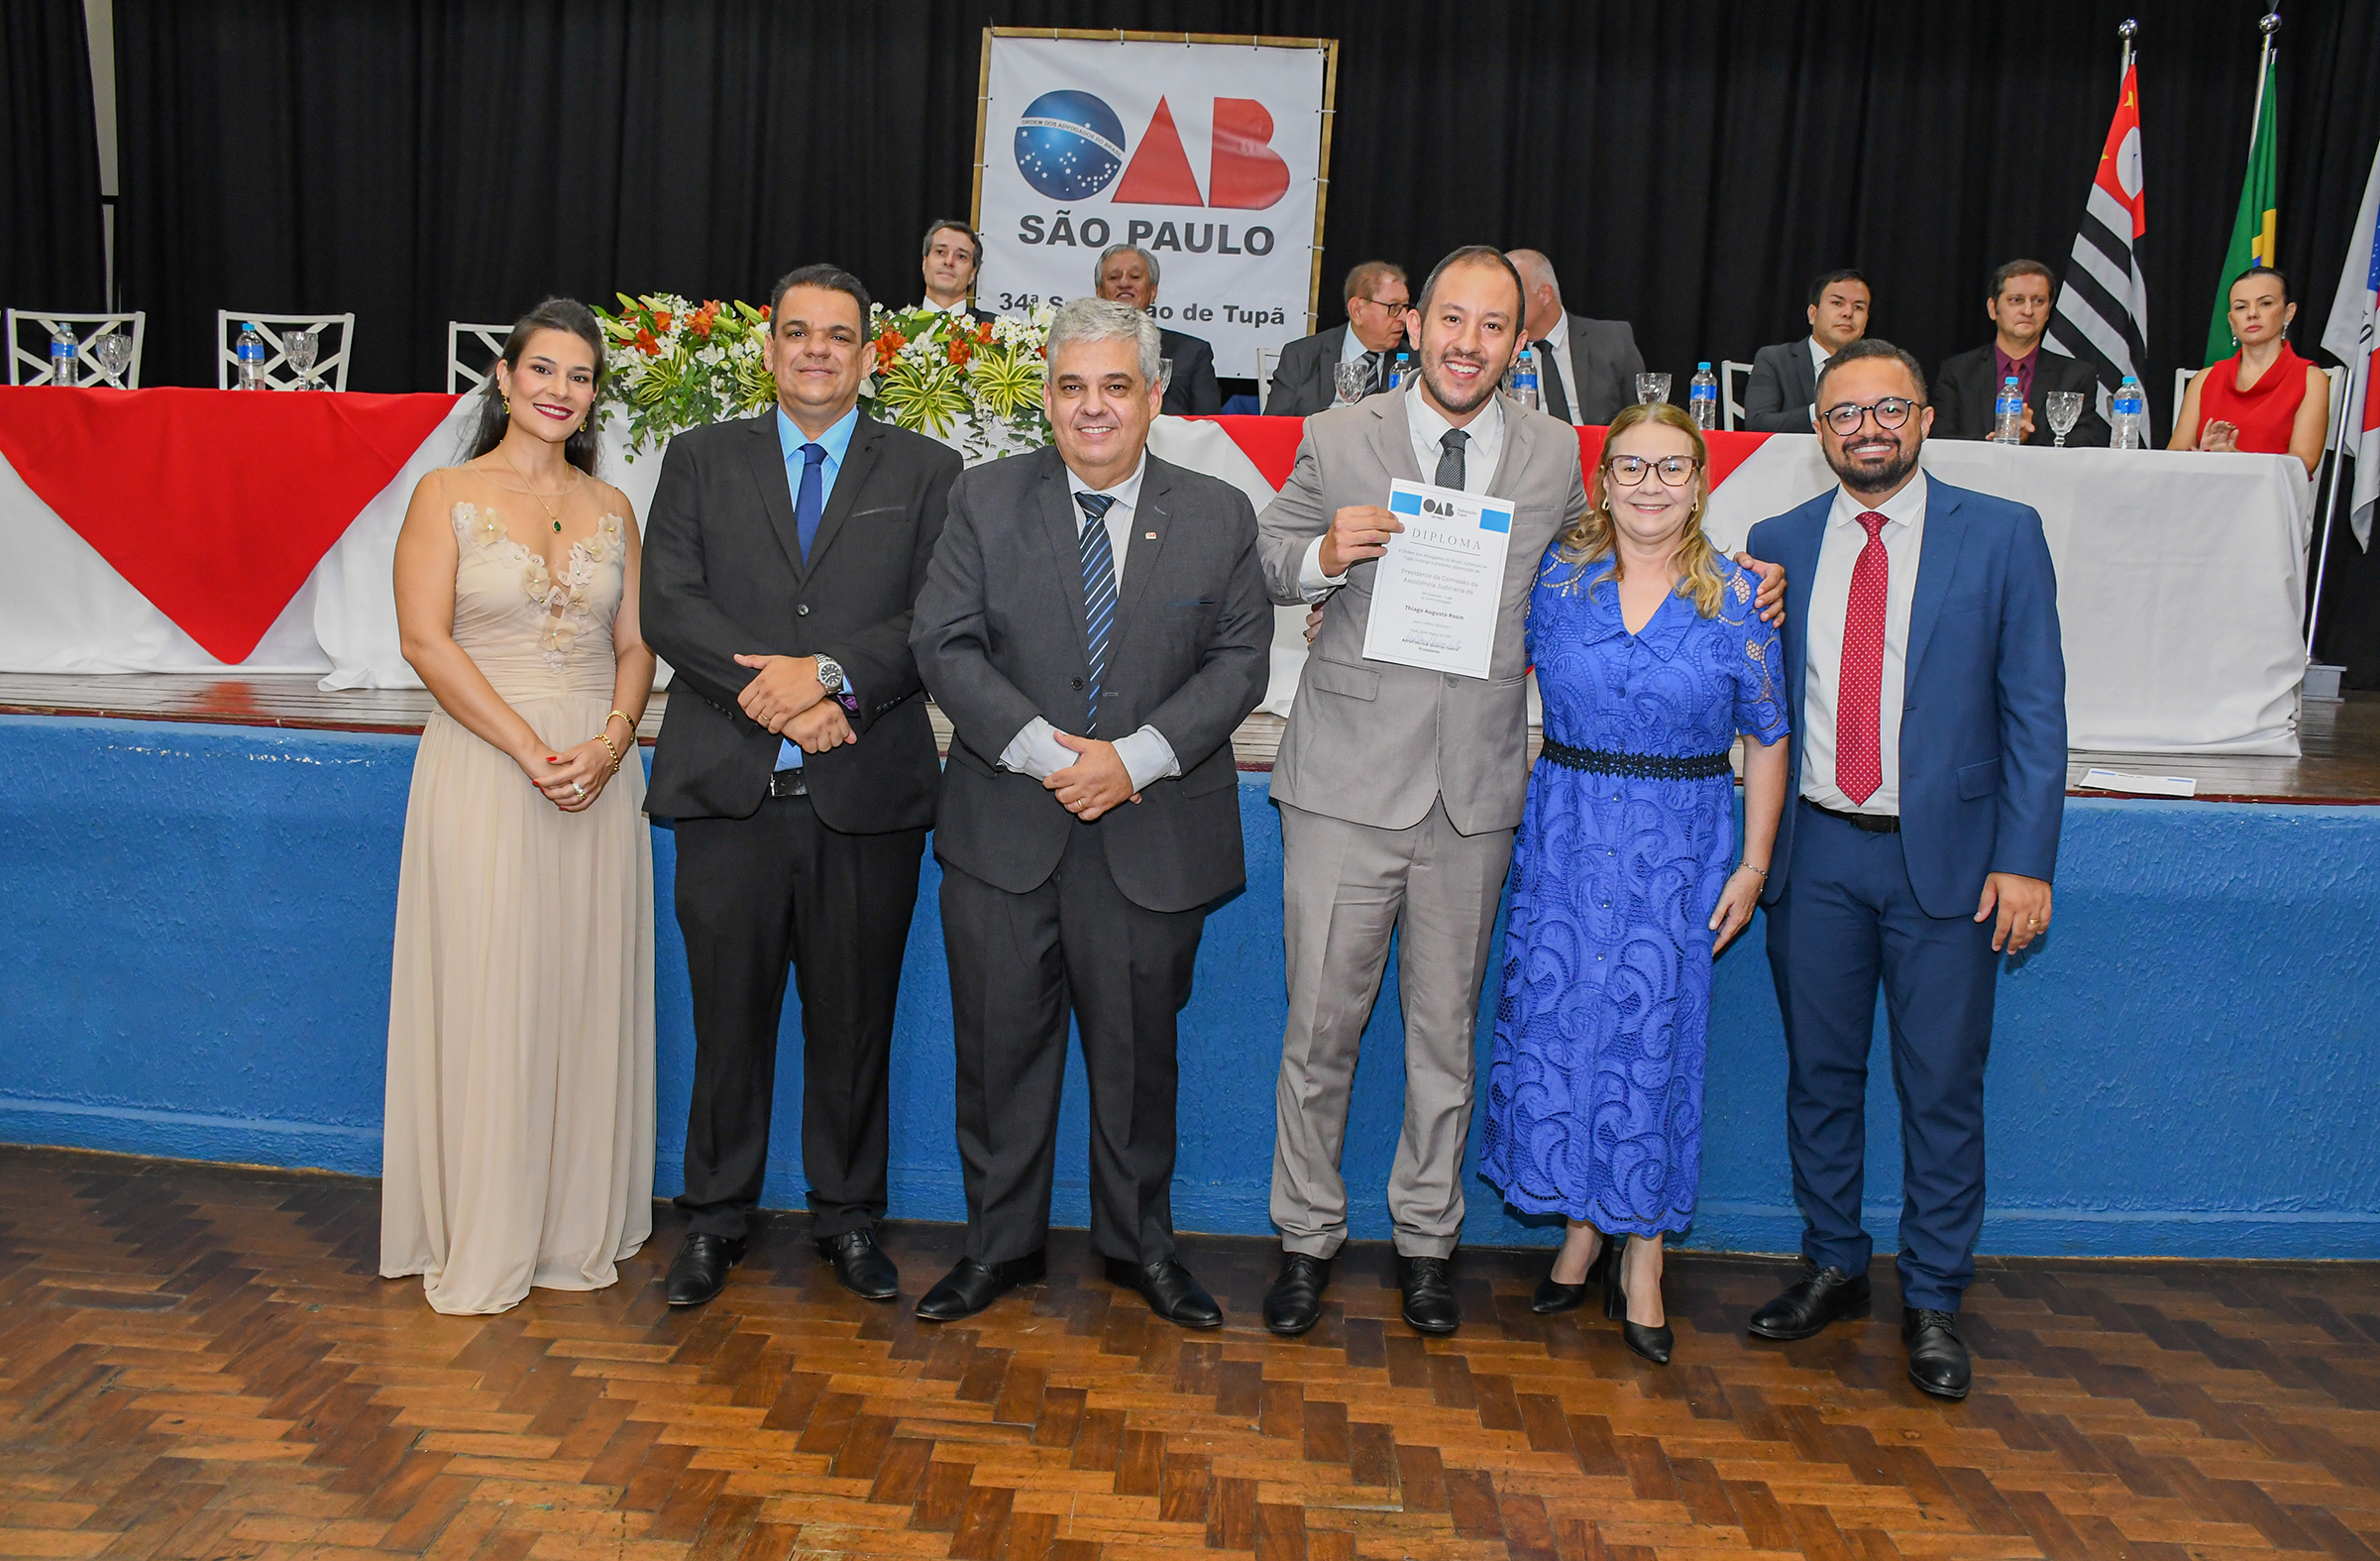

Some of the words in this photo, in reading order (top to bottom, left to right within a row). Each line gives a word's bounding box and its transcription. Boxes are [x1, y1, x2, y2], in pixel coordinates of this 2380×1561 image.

[1014, 89, 1290, 211] OAB
[1057, 123, 1095, 140] ADVOGADOS
[1095, 136, 1105, 145] DO
[1104, 142, 1123, 158] BRASIL
[1018, 209, 1111, 248] SÃO
[1127, 219, 1275, 257] PAULO
[999, 292, 1039, 310] 34ª
[1182, 303, 1214, 321] de
[1223, 304, 1285, 328] Tupã
[1423, 499, 1455, 517] OAB
[1412, 527, 1480, 550] DIPLOMA
[1401, 568, 1433, 579] Presidente
[1441, 575, 1470, 586] Comissão
[1403, 577, 1436, 589] Assistência
[1437, 583, 1465, 594] Judiciária
[1405, 605, 1424, 613] Thiago
[1424, 609, 1448, 617] Augusto
